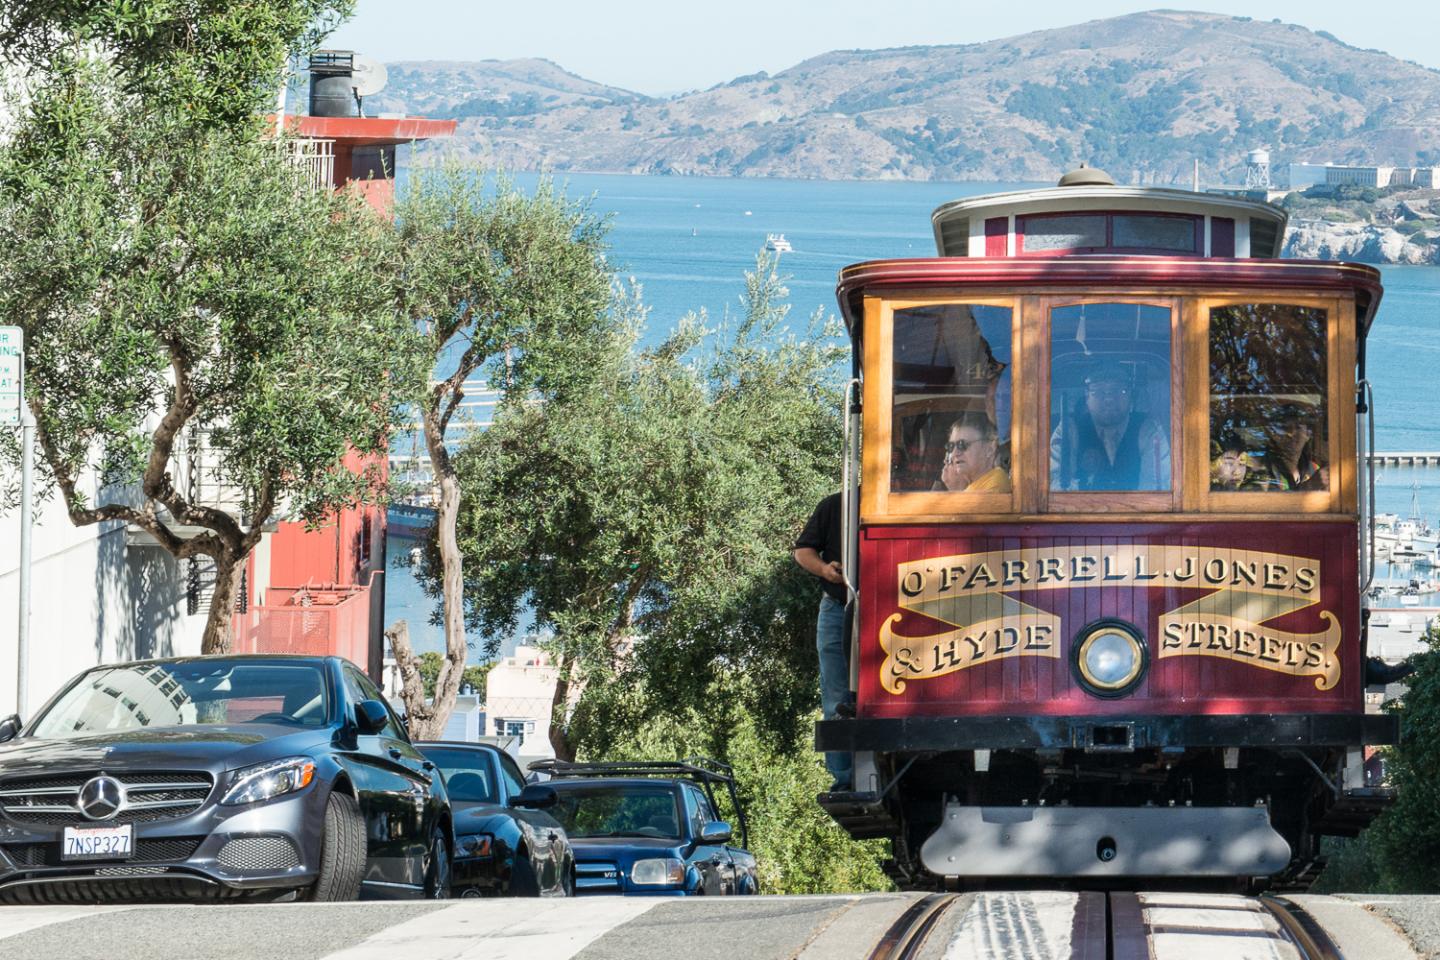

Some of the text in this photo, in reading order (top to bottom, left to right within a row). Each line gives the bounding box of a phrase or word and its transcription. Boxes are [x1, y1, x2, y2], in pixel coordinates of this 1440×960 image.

[891, 624, 1053, 676] & HYDE
[67, 835, 129, 854] 7NSP327
